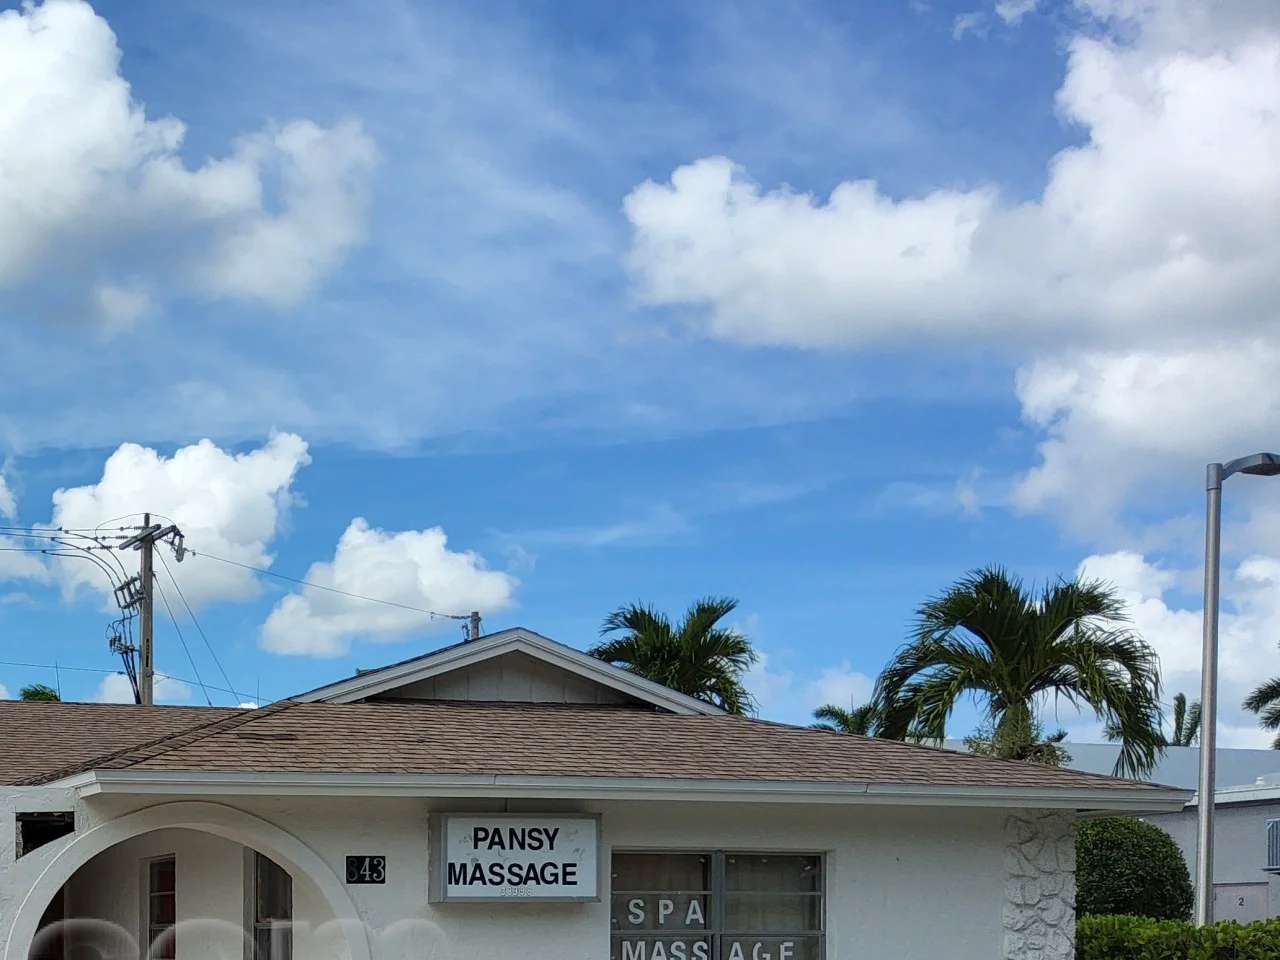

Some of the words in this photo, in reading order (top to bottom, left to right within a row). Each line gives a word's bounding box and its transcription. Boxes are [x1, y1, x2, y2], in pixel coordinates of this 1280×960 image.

[473, 826, 560, 850] PANSY
[347, 857, 385, 881] 843
[448, 862, 578, 886] MASSAGE
[628, 898, 705, 924] SPA
[1238, 897, 1245, 906] 2
